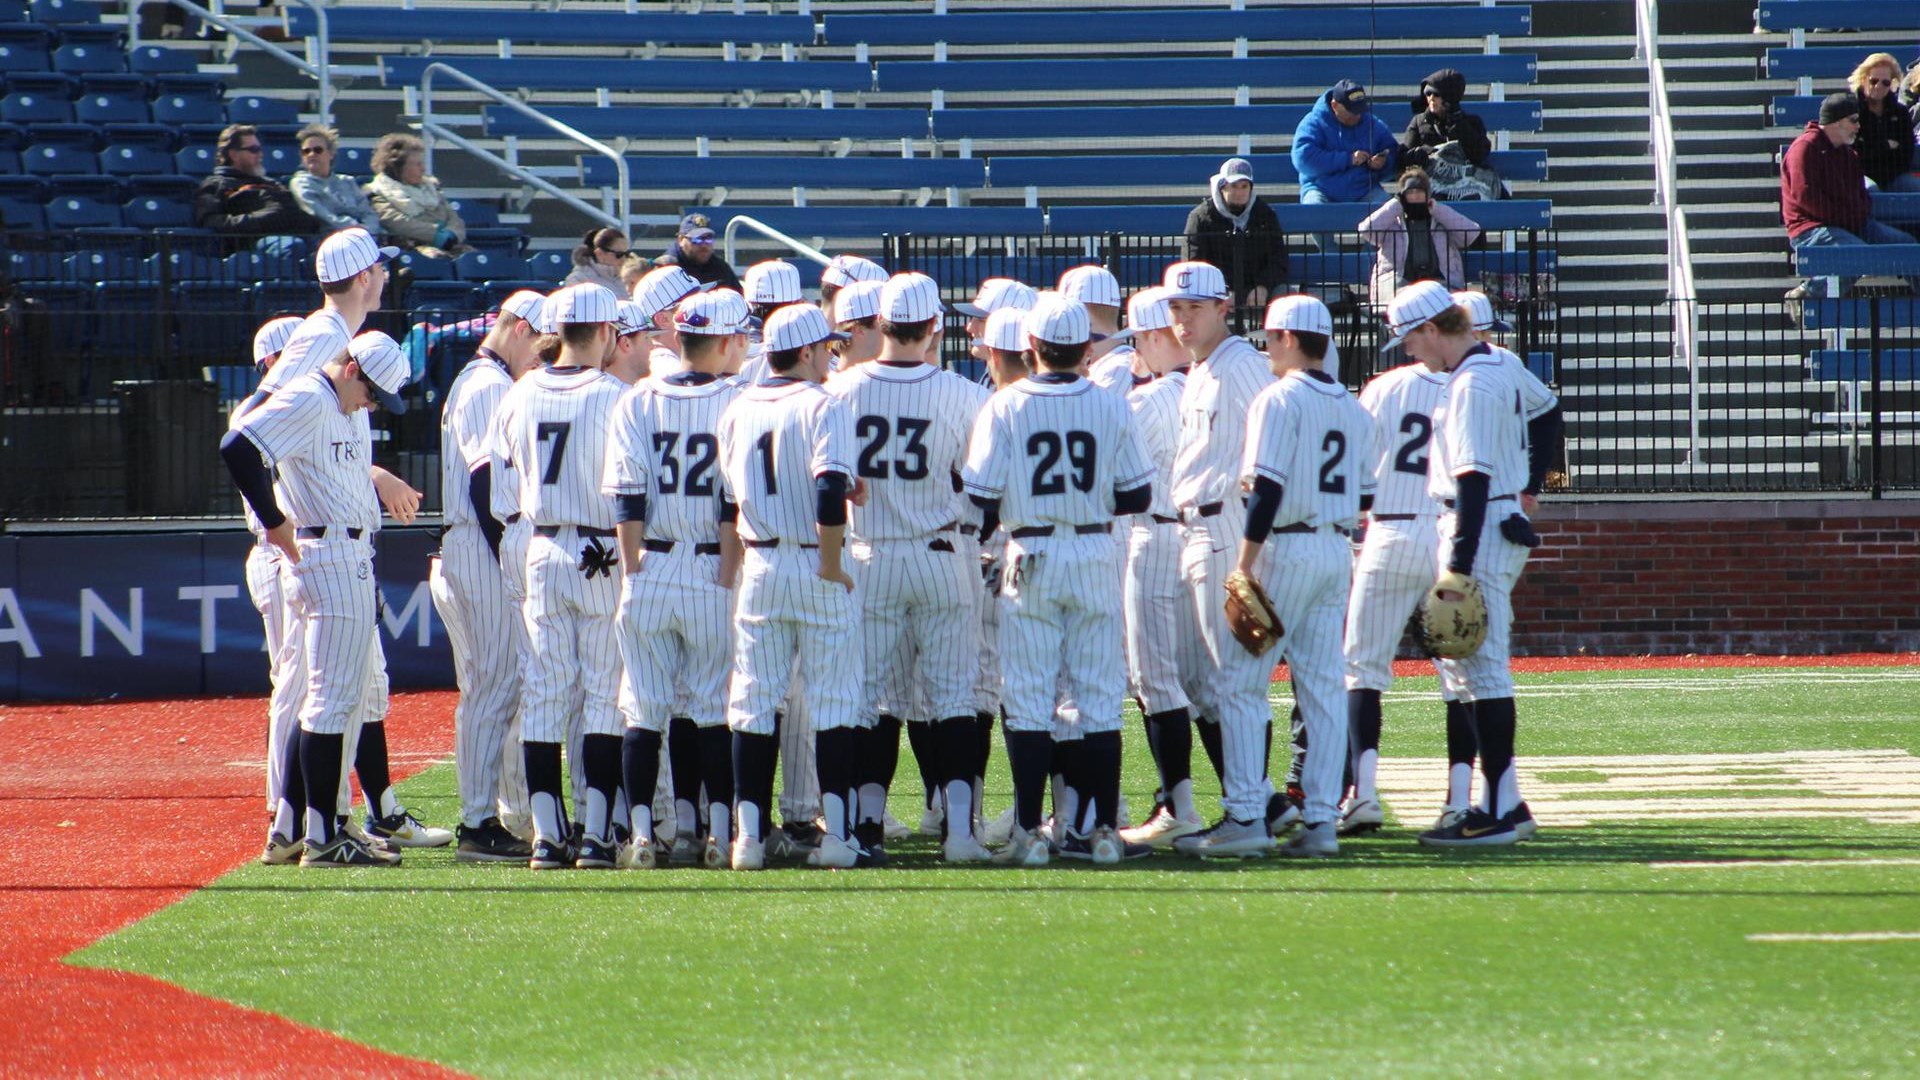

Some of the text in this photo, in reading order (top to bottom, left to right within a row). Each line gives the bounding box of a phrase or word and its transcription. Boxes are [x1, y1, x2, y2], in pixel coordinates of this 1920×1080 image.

[537, 422, 571, 485] 7
[652, 431, 719, 496] 32
[757, 430, 778, 495] 1
[856, 415, 930, 480] 23
[1026, 430, 1096, 496] 29
[1319, 430, 1346, 494] 2
